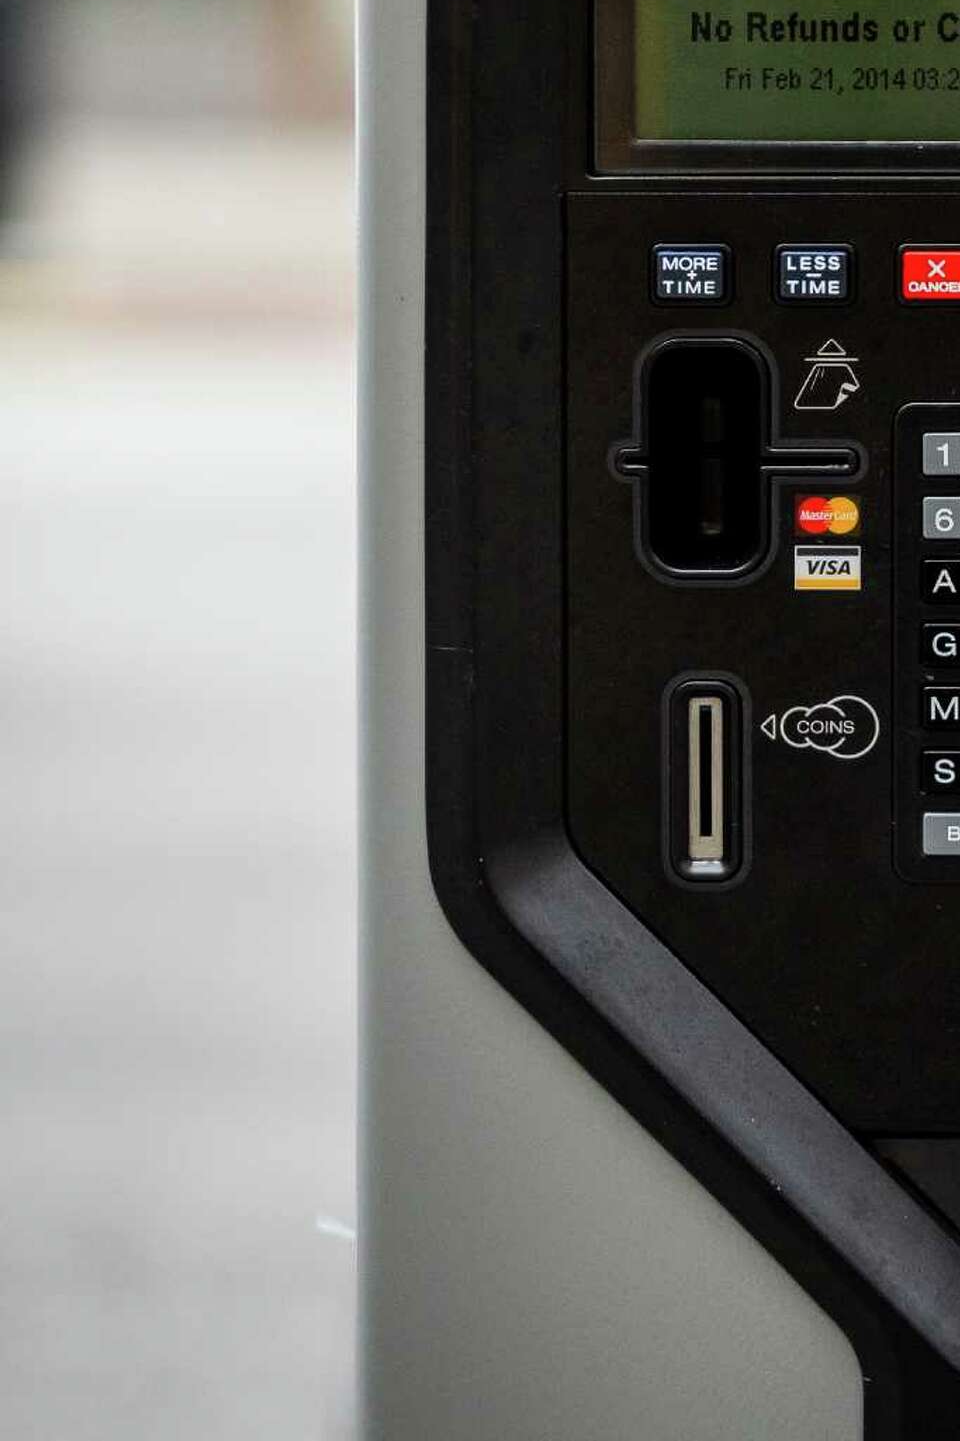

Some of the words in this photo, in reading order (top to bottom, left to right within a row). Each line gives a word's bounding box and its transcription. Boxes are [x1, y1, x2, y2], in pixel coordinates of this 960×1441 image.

[691, 12, 733, 42] No
[747, 12, 878, 44] Refunds
[893, 20, 925, 42] or
[725, 68, 751, 90] Fri
[762, 68, 801, 90] Feb
[810, 68, 844, 95] 21,
[853, 68, 906, 90] 2014
[662, 257, 717, 271] MORE
[787, 257, 840, 271] LESS
[662, 281, 715, 294] TIME
[787, 280, 839, 294] TIME
[937, 443, 948, 466] 1
[935, 509, 954, 531] 6
[807, 560, 850, 575] VISA
[933, 570, 956, 593] A
[933, 632, 956, 656] G
[931, 697, 958, 720] M
[797, 720, 855, 735] COINS
[935, 759, 955, 783] S
